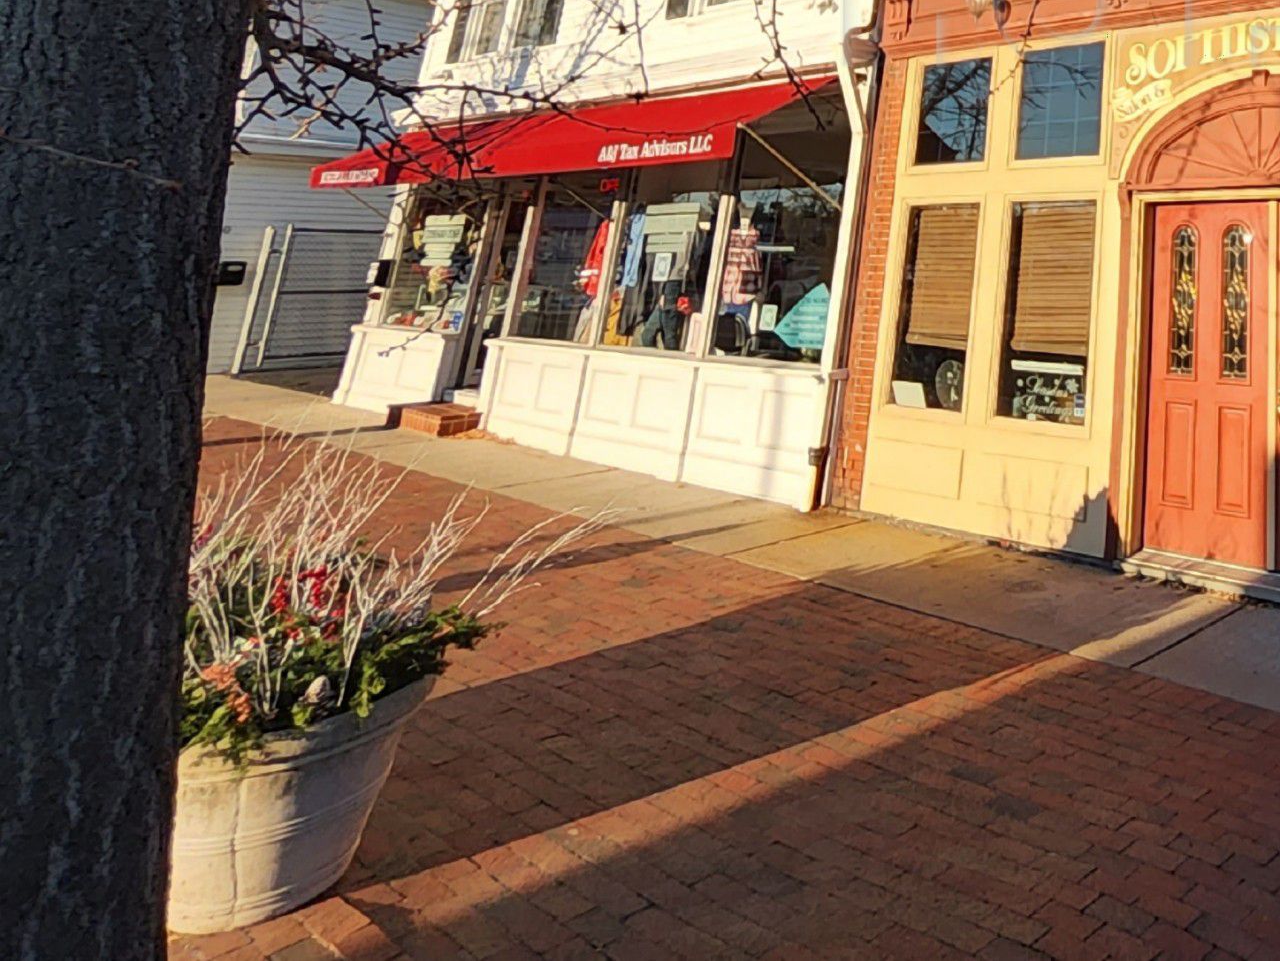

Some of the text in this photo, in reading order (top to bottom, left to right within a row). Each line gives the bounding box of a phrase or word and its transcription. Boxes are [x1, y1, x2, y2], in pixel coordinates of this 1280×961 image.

[619, 143, 640, 160] Tax
[640, 139, 688, 158] Advisors
[688, 134, 714, 154] LLC
